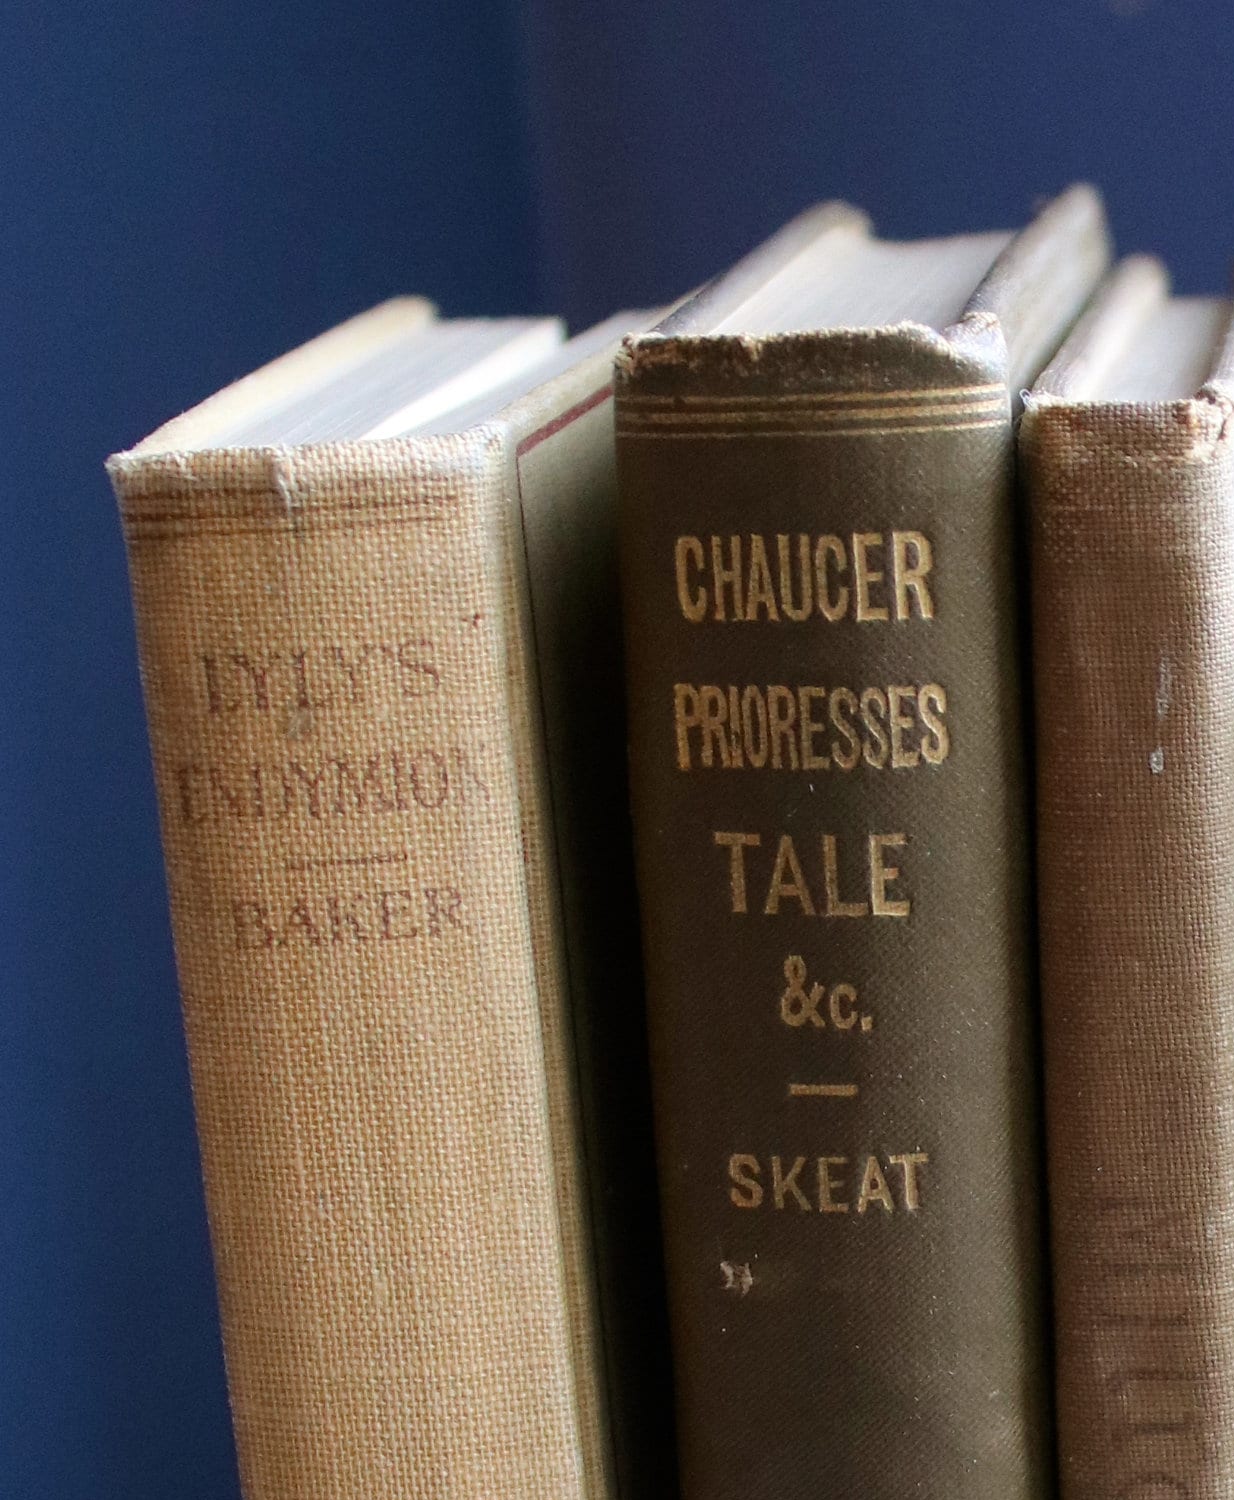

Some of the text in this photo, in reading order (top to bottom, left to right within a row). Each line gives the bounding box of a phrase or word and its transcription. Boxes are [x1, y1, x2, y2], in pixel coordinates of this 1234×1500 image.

[673, 530, 936, 623] CHAUCER
[673, 682, 952, 770] PRIORESSES
[714, 831, 911, 917] TALE
[230, 886, 463, 951] BAKER
[780, 955, 874, 1032] &c.
[727, 1151, 930, 1216] SKEAT
